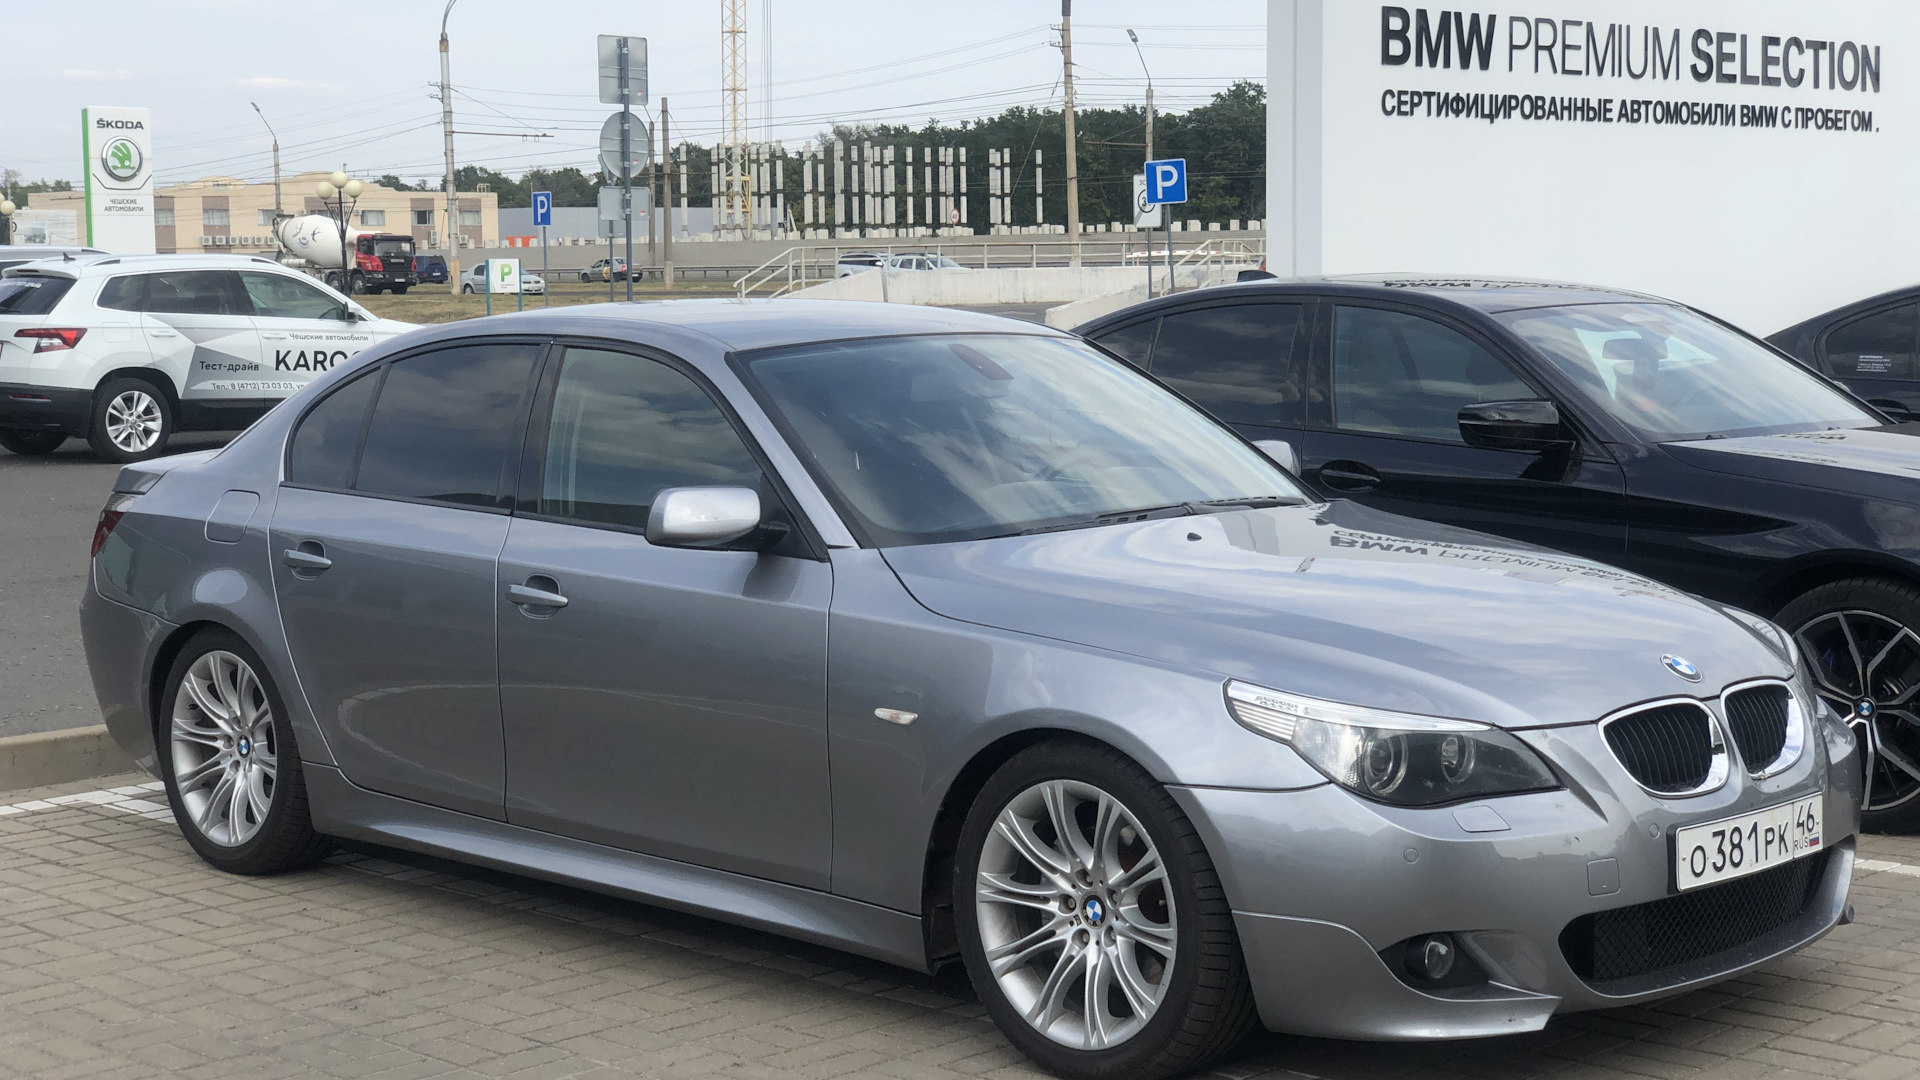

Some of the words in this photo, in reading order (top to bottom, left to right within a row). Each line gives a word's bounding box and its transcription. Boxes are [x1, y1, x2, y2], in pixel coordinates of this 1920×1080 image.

[1381, 6, 1497, 71] BMW
[1508, 15, 1680, 80] PREMIUM
[1690, 28, 1880, 93] SELECTION
[1381, 89, 1614, 124] СЕРТИФИЦИРОВАННЫЕ
[1617, 98, 1736, 127] АВТОМОБИЛИ
[1740, 104, 1778, 128] BMW
[1781, 105, 1792, 129] С
[96, 117, 145, 130] ŠKODA
[1156, 165, 1178, 199] P
[537, 195, 548, 223] P
[500, 263, 513, 283] P
[289, 332, 324, 341] Чешские
[325, 333, 369, 342] автомобили
[199, 360, 260, 373] Тест-драйв
[275, 350, 361, 372] KARO
[238, 382, 260, 391] (4712)
[272, 382, 282, 390] 03
[1797, 802, 1815, 836] 46
[1794, 836, 1809, 851] RUS
